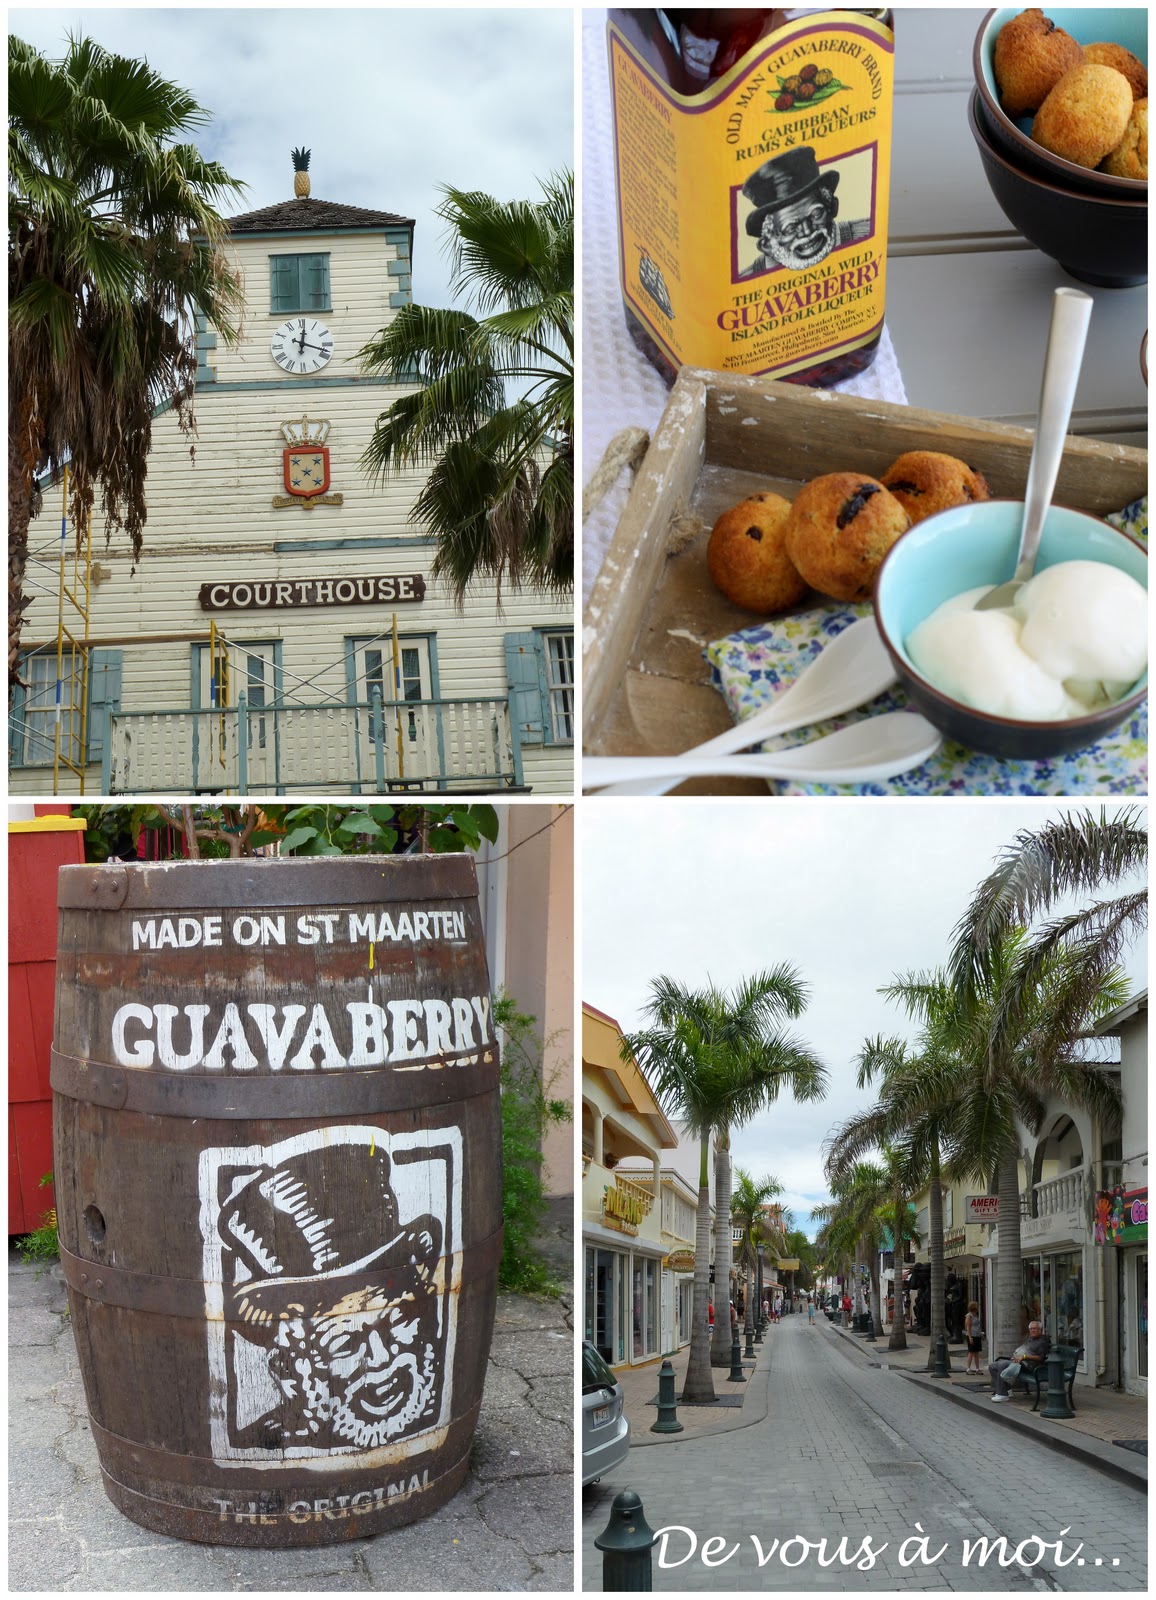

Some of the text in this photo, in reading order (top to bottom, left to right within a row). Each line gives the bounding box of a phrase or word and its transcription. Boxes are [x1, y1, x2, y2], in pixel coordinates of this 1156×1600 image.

[726, 39, 882, 145] OLD MAN GUAVABERRY BRAND
[735, 107, 877, 161] RUMS & LIQUEURS
[761, 105, 850, 142] CARIBBEAN
[716, 253, 883, 332] GUAVABERRY
[732, 250, 873, 307] THE ORIGINAL WILD
[725, 354, 745, 363] SINT
[746, 341, 782, 359] MAARTEN
[782, 323, 830, 346] GUAVABERRY
[831, 311, 864, 329] COMPANY
[730, 284, 873, 343] ISLAND FOLK LIQUEUR
[752, 327, 799, 349] Manufactured
[808, 315, 833, 329] Bottled
[767, 335, 839, 364] www.guavaberry.com
[210, 576, 415, 607] COURTHOUSE
[131, 911, 466, 951] MADE ON ST MAARTEN
[111, 995, 493, 1070] GUAVABERRY
[213, 1469, 434, 1526] THE ORIGINAL
